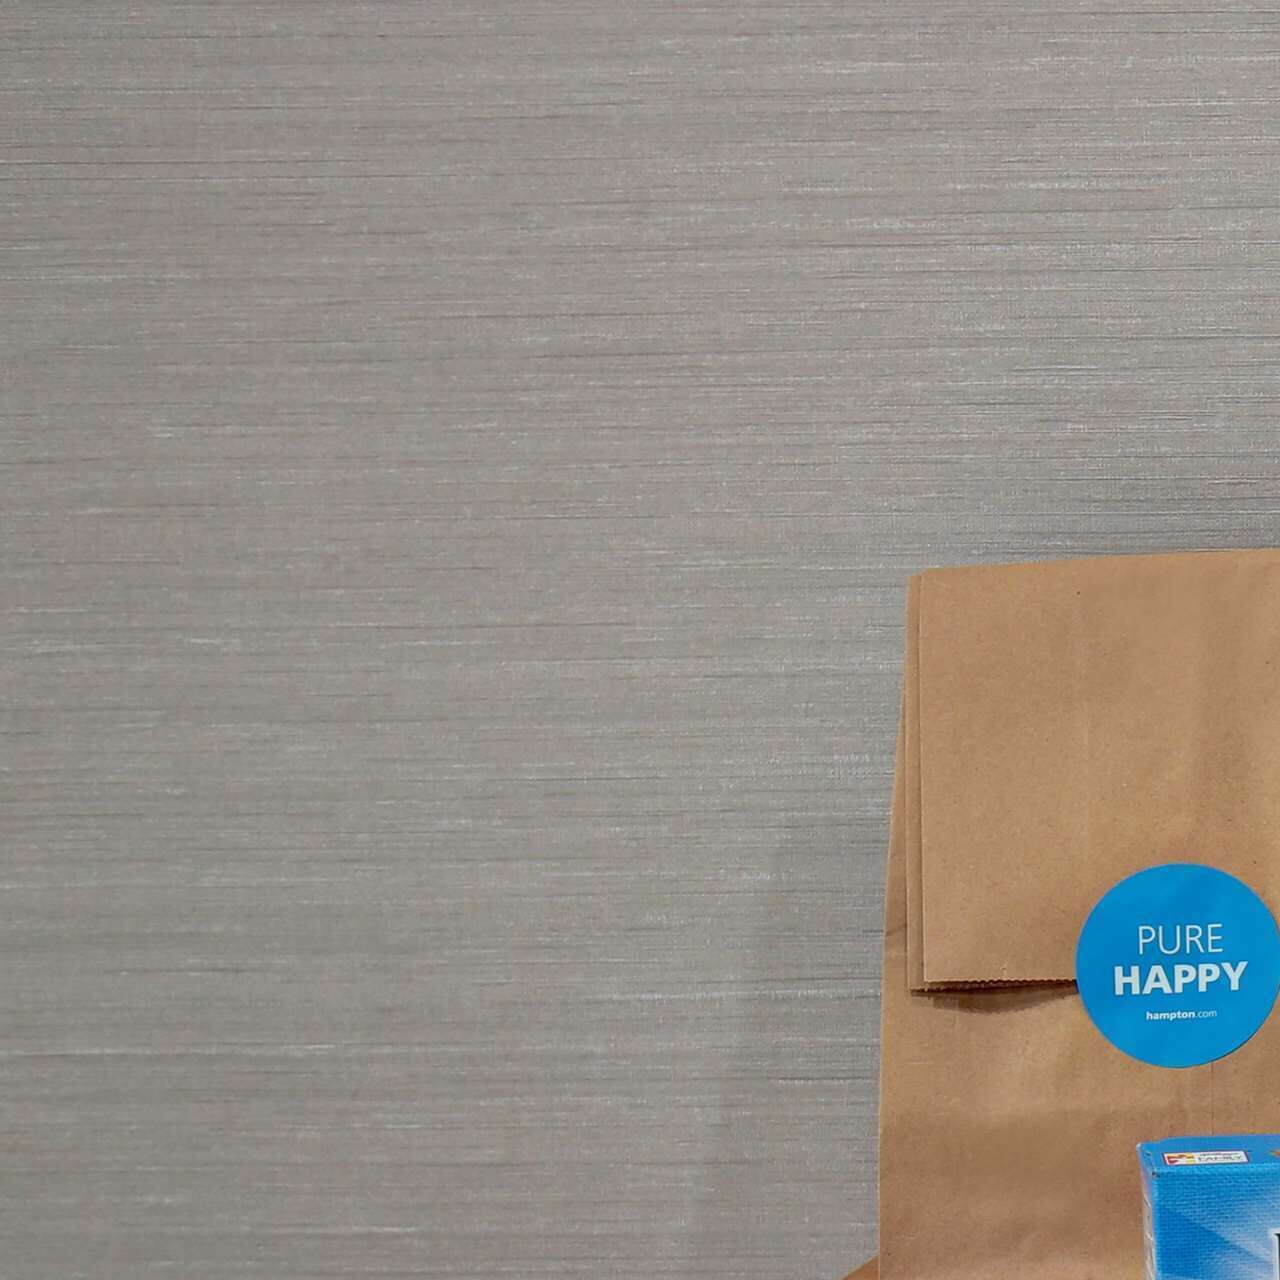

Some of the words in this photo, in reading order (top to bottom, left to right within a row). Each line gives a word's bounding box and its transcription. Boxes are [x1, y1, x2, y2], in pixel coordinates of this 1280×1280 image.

[1138, 923, 1223, 955] PURE
[1113, 961, 1248, 996] HAPPY
[1145, 1009, 1217, 1021] hampton.com
